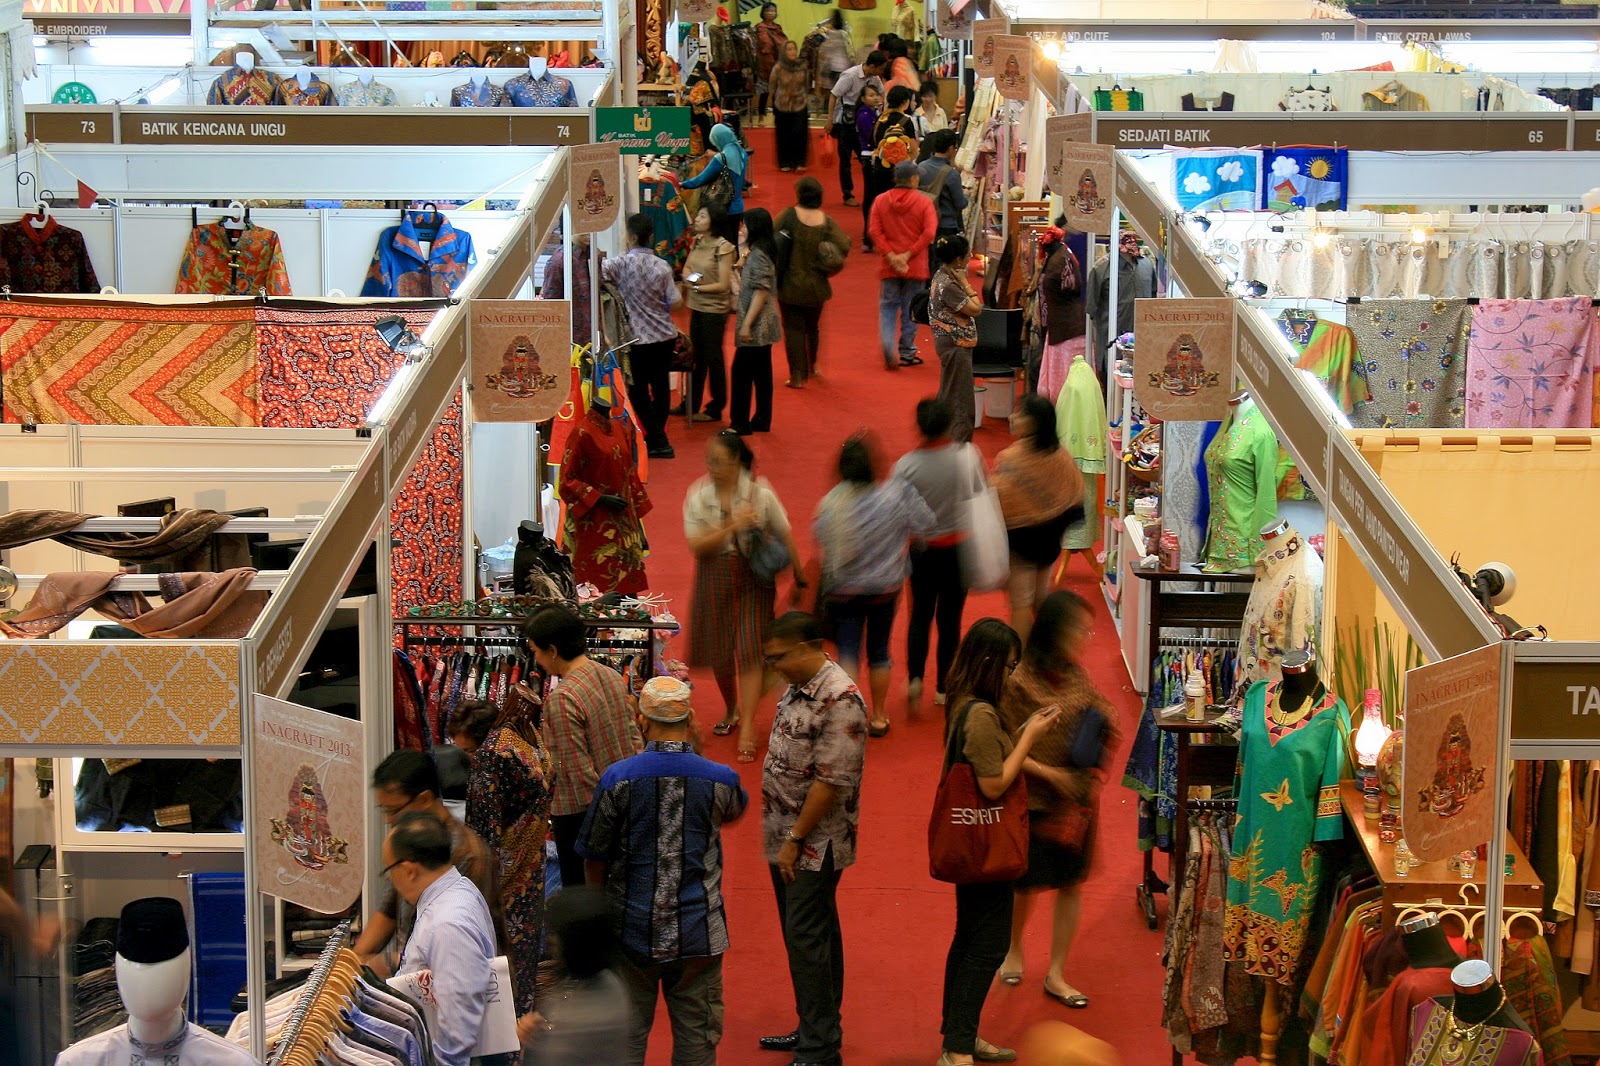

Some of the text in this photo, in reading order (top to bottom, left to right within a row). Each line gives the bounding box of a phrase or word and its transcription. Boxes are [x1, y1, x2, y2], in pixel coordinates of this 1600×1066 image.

[47, 26, 108, 35] EMBROIDERY
[1026, 31, 1110, 41] KENEZ AND CUTE
[1320, 31, 1336, 41] 104
[1438, 32, 1472, 41] LAWAS
[81, 121, 96, 134] 73
[142, 122, 287, 137] BATIK KENCANA UNGU
[556, 125, 571, 138] 74
[1119, 129, 1211, 142] SEDJATI BATIK
[1528, 130, 1544, 143] 65
[479, 315, 561, 323] INACRAFT 2013
[1144, 312, 1225, 321] INACRAFT 2013
[1395, 543, 1409, 585] WEAR
[1416, 676, 1472, 706] INACRAFT
[1474, 669, 1493, 687] 2013
[1566, 685, 1600, 715] TA
[262, 720, 325, 749] INACRAFT
[328, 740, 351, 757] 2013
